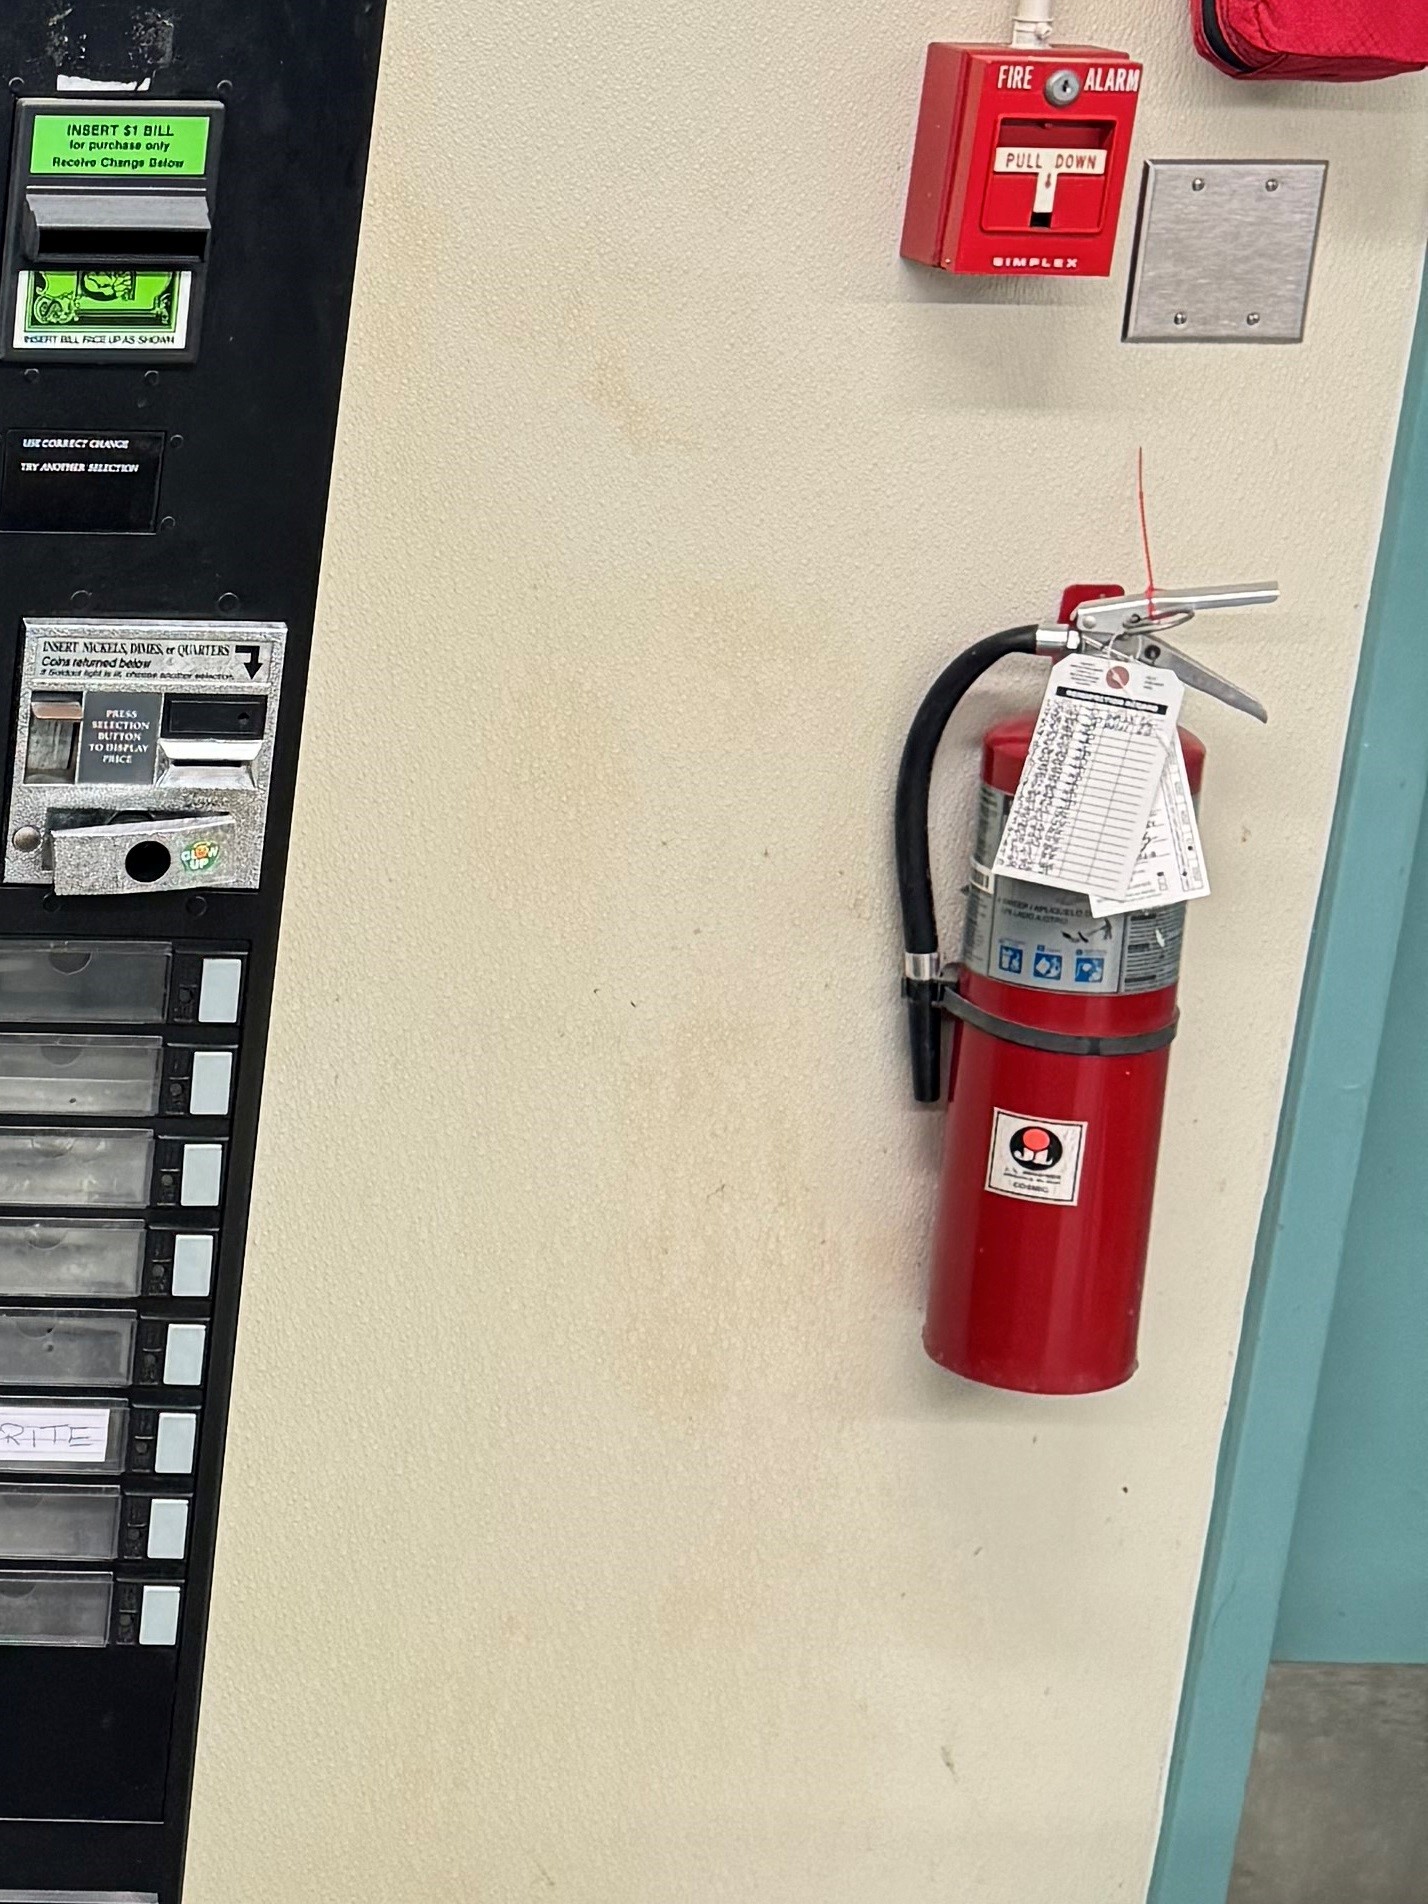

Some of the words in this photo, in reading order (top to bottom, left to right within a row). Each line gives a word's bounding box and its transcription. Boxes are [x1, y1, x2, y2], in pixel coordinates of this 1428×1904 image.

[997, 65, 1034, 90] FIRE
[1083, 67, 1141, 93] ALARM
[66, 124, 119, 137] INSERT
[123, 124, 138, 137] $1
[143, 125, 174, 137] BILL
[69, 140, 85, 150] for
[88, 140, 142, 152] purchase
[145, 141, 170, 152] only
[100, 157, 145, 170] Change
[149, 158, 184, 169] Below
[1005, 152, 1043, 170] PULL
[1054, 153, 1097, 170] DOWN
[992, 257, 1078, 268] SIMPLEX
[42, 439, 88, 448] CORRECT
[89, 439, 129, 449] CHANGE
[40, 463, 86, 472] ANOTHER
[87, 463, 139, 473] SELECTION
[42, 641, 78, 653] INSERT
[177, 644, 230, 657] QUARTERS
[41, 656, 71, 667] Coins
[72, 657, 117, 668] returned
[119, 658, 152, 669] below
[106, 709, 138, 719] PRESS
[92, 721, 150, 730] SELECTION
[97, 732, 142, 741] BUTTON
[89, 743, 104, 752] TO
[105, 743, 149, 754] DISPLAY
[102, 755, 132, 764] PRICE
